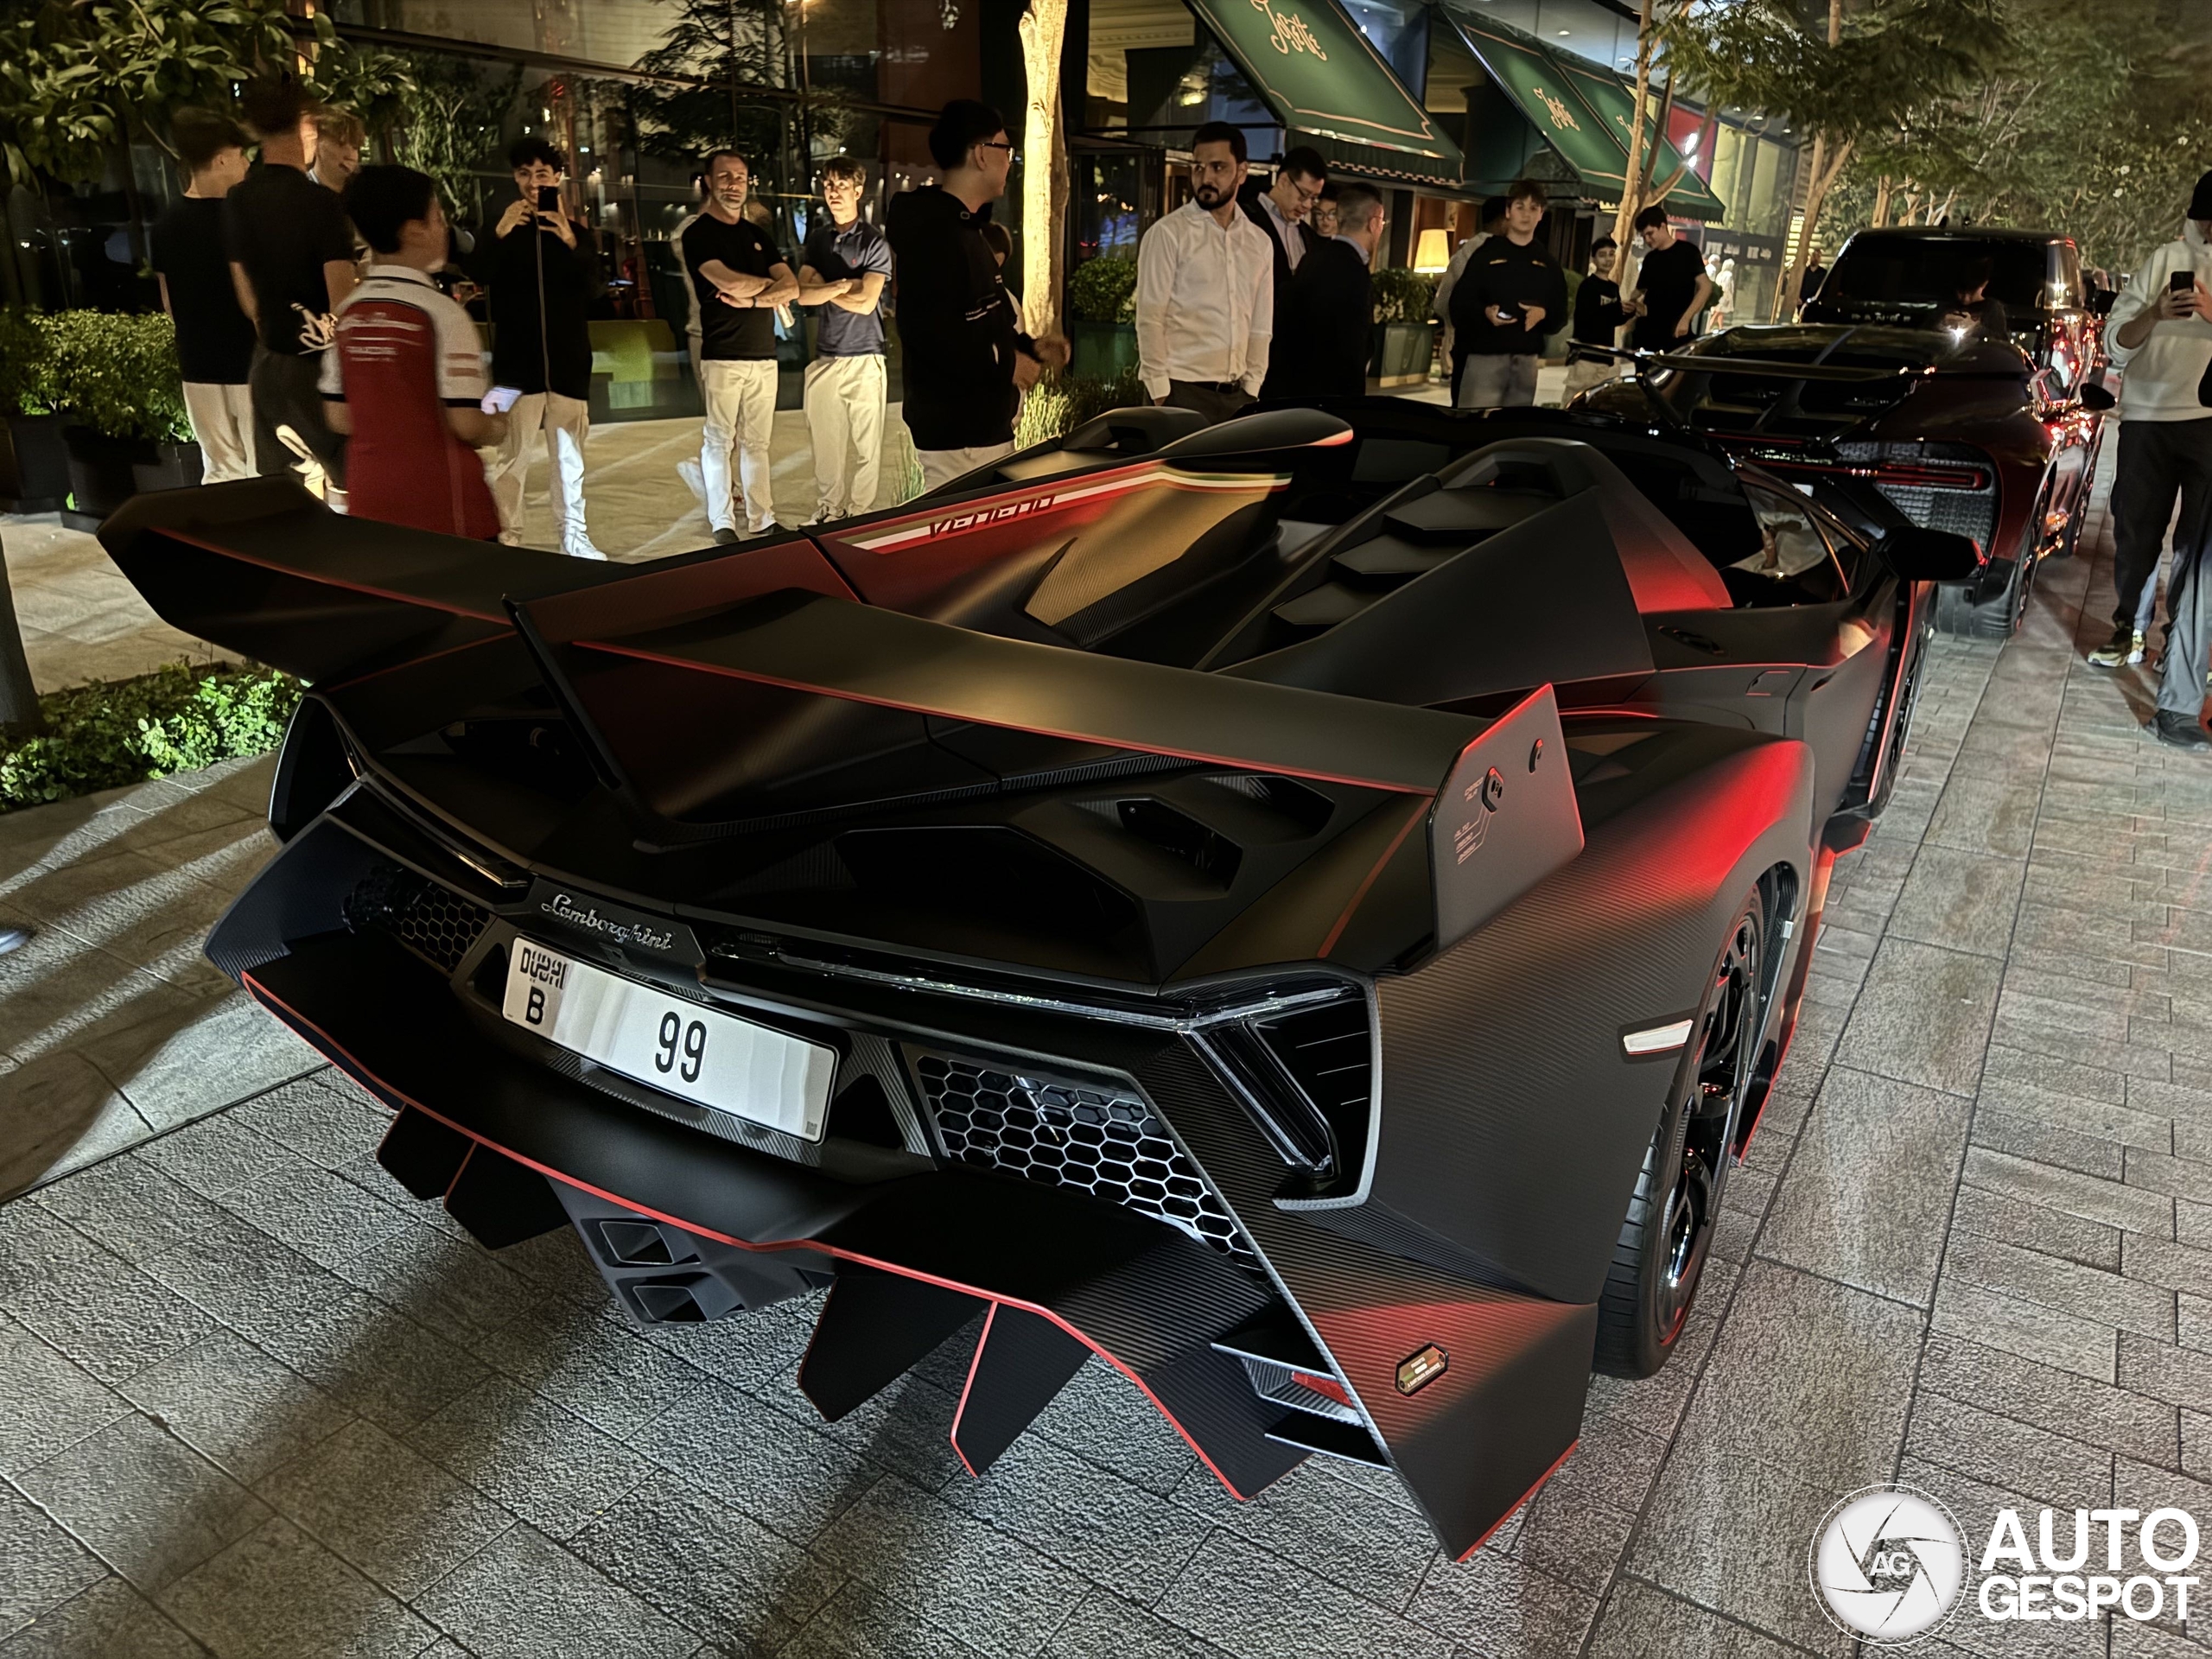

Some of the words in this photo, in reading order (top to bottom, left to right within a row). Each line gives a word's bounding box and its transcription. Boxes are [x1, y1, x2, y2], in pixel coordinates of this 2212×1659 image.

[541, 893, 672, 950] Lamborghini
[525, 986, 545, 1026] B
[655, 1011, 707, 1084] 99
